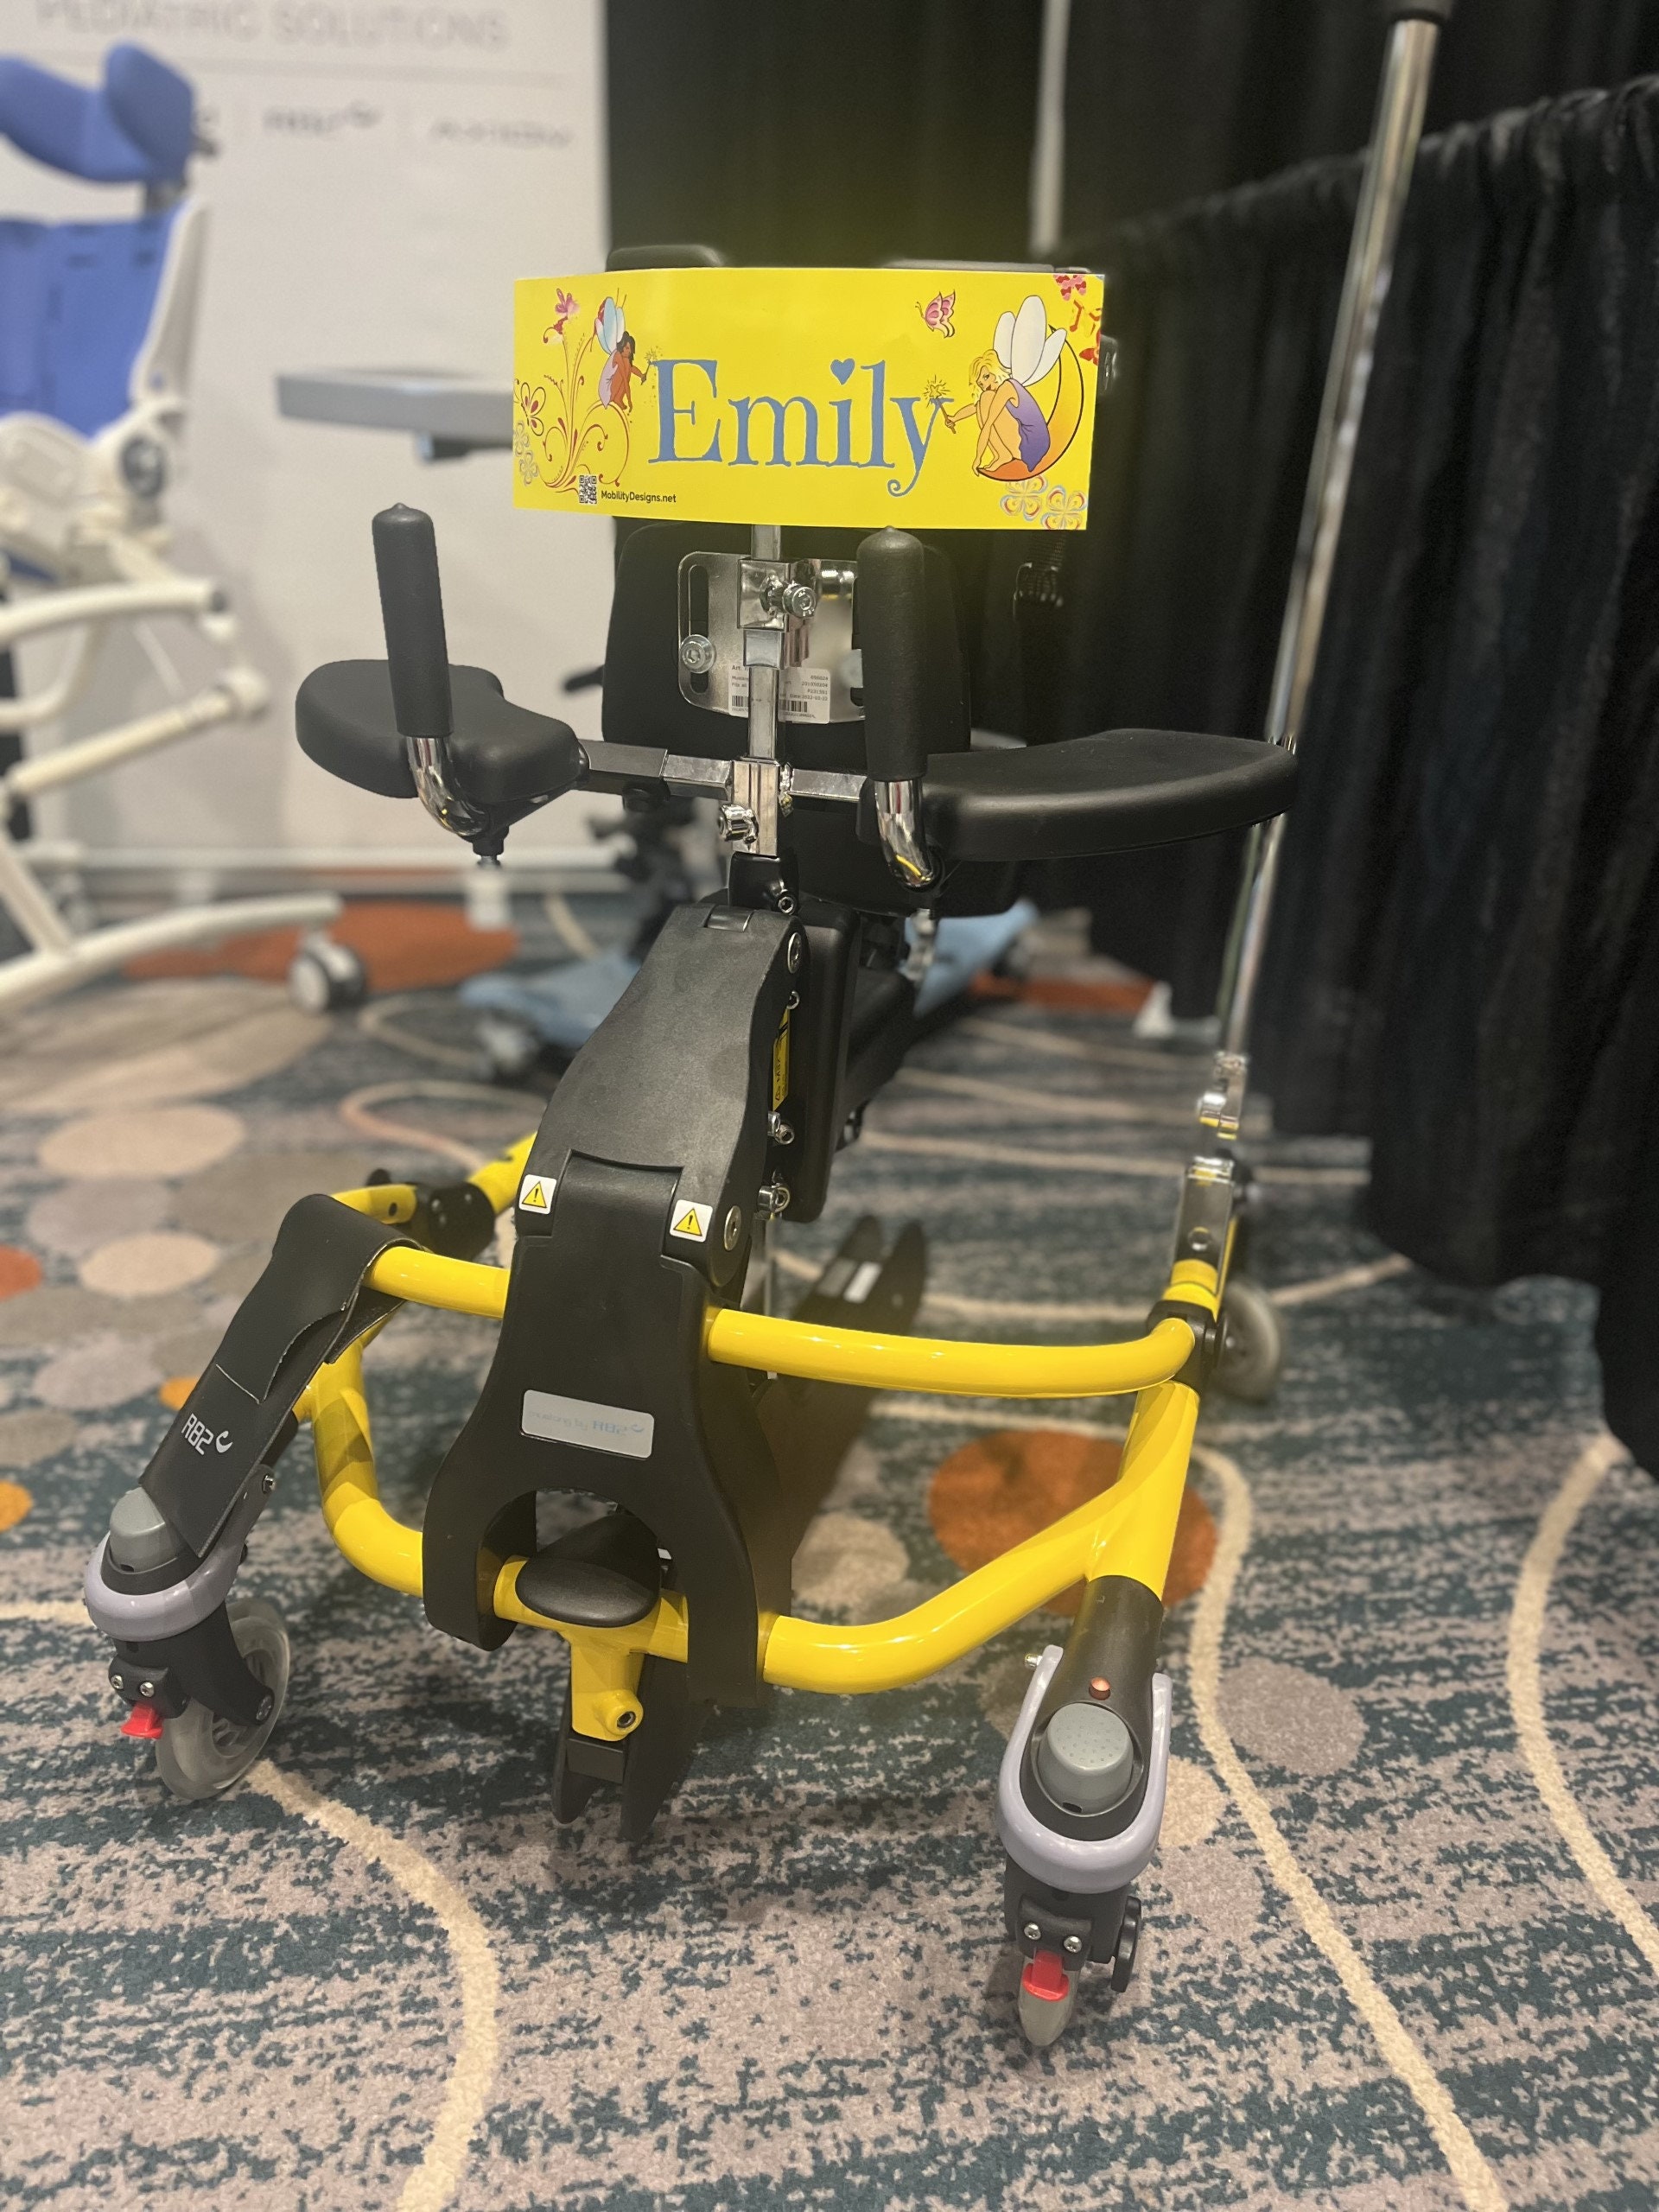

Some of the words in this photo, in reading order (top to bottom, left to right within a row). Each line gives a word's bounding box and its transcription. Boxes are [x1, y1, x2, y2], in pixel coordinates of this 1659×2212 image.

[648, 358, 954, 497] Emily
[601, 490, 677, 504] MobilityDesigns.net
[181, 1413, 214, 1456] R82
